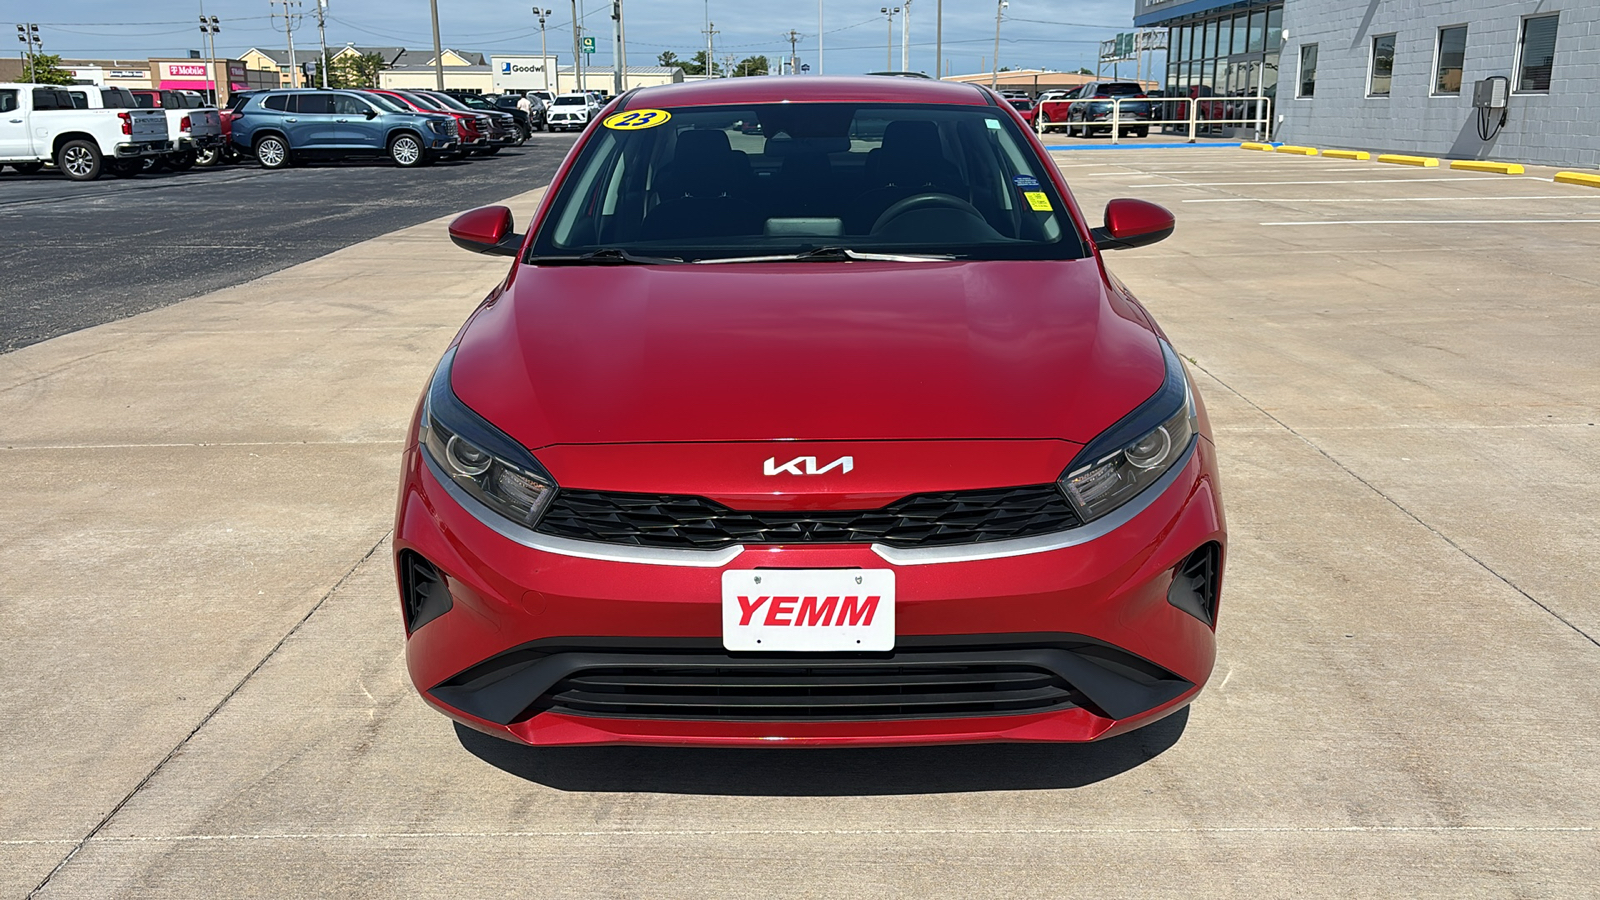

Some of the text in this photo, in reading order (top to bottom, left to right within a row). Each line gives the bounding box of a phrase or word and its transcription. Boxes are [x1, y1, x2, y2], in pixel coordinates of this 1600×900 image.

[178, 66, 204, 75] Mobile
[512, 65, 545, 73] Goodwi
[614, 112, 658, 127] 23
[763, 456, 854, 476] KIA
[736, 595, 881, 627] YEMM
